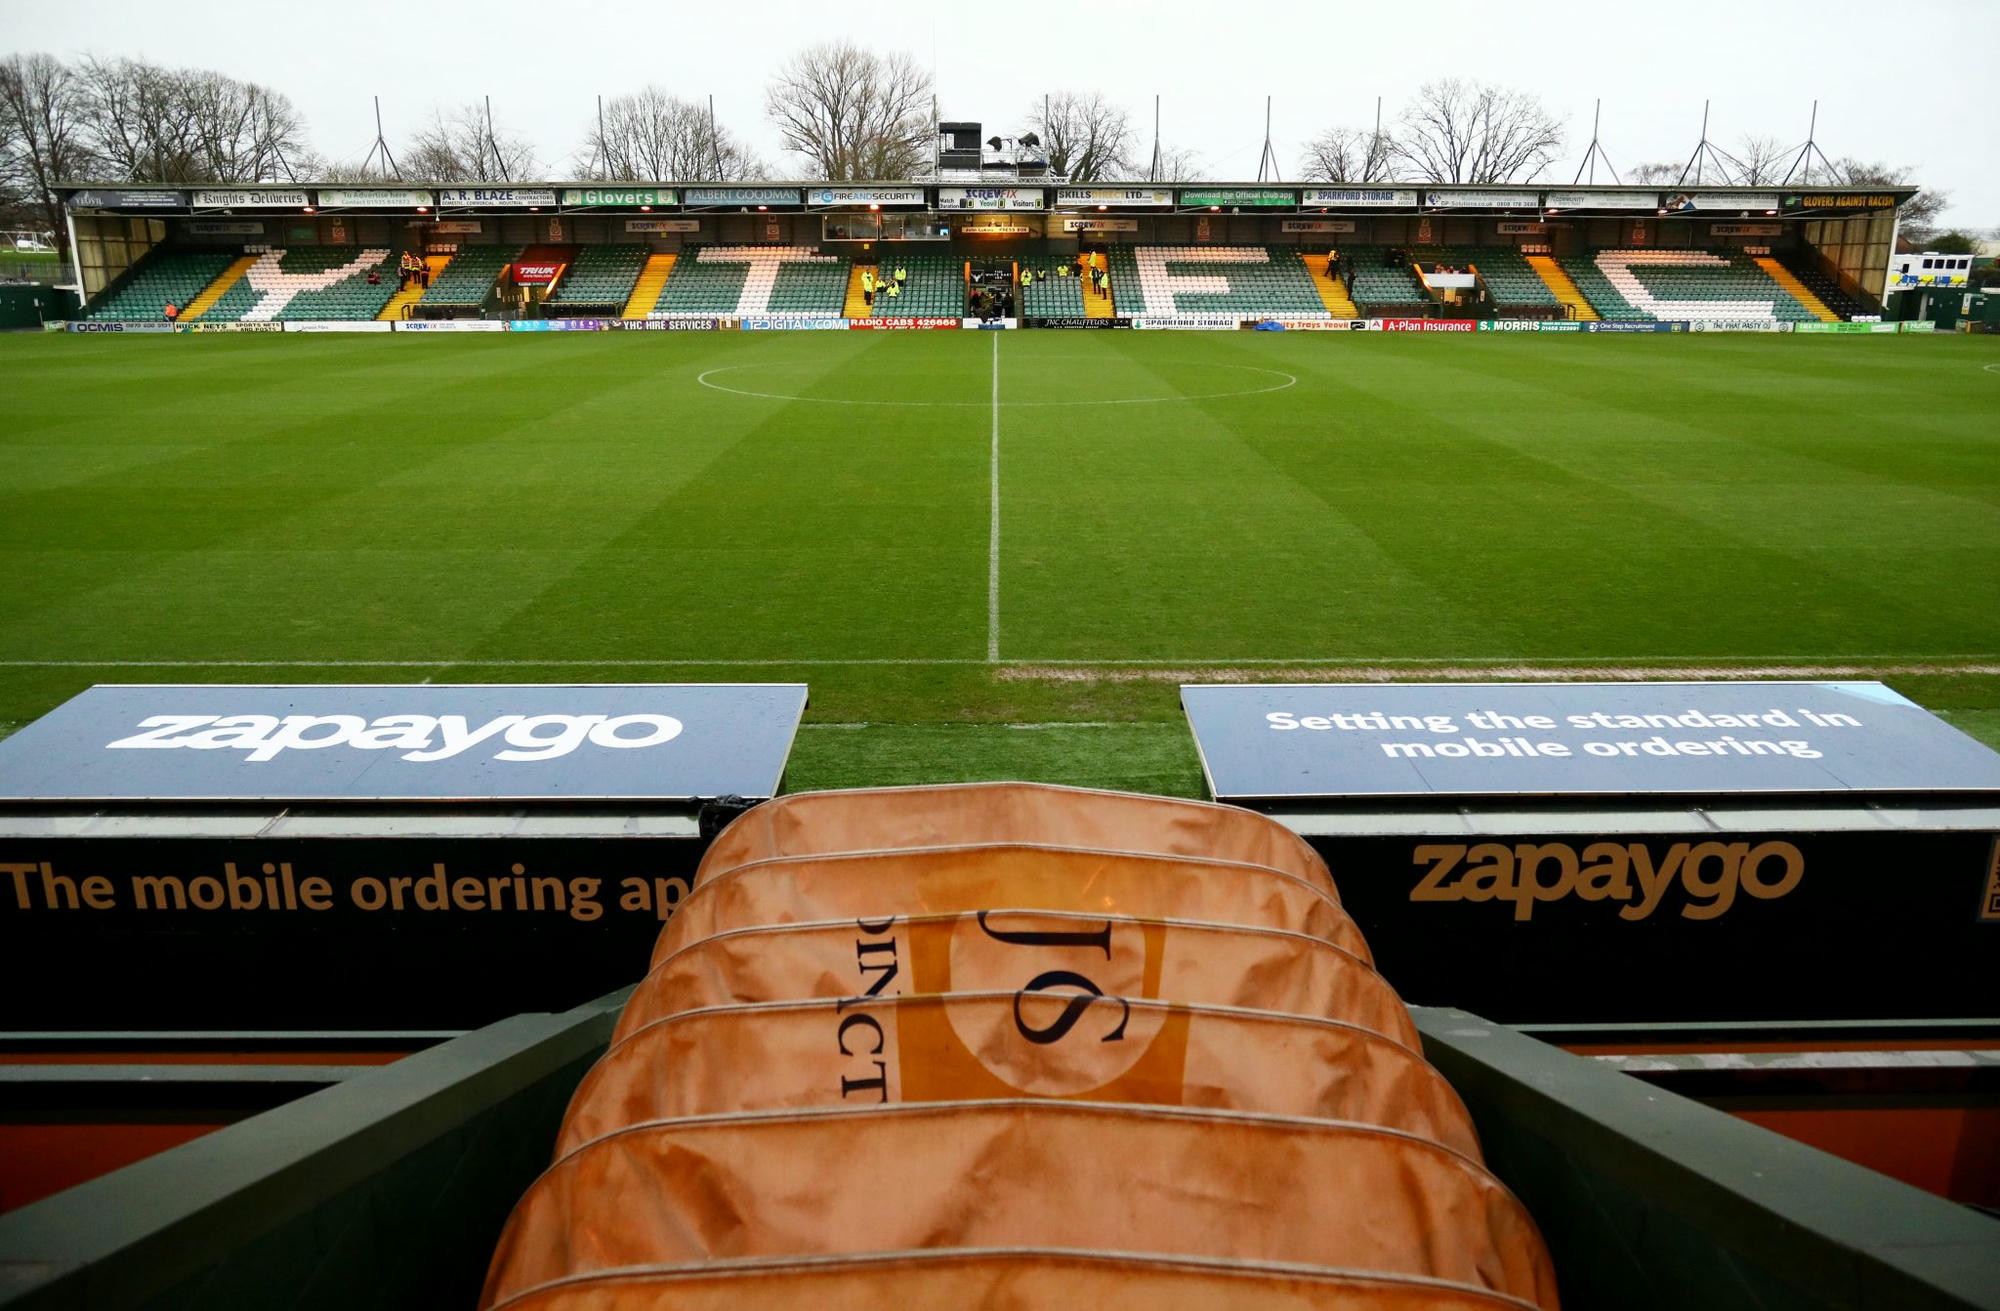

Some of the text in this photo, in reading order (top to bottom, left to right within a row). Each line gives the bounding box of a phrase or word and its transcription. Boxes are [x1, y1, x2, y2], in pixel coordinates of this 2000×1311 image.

[203, 192, 303, 206] Knights Deliveries
[442, 191, 513, 201] A. R. BLAZE
[586, 191, 654, 204] Glovers
[694, 190, 800, 200] ALBERT GOODMAN
[965, 189, 1018, 200] SCREWFIX
[1184, 190, 1293, 200] Download the Official Club app
[1318, 191, 1394, 201] SPARKFORD STORAGE
[980, 199, 997, 207] Yeovil
[1012, 200, 1034, 208] Visitors
[1803, 195, 1895, 208] GLOVERS AGAINST RACISM
[77, 323, 123, 332] OCMIS
[623, 320, 712, 330] YHC HIRE SERVICES
[1298, 321, 1321, 329] Trays
[1388, 321, 1471, 331] A-Plan Insurance
[1493, 321, 1540, 331] MORRIS
[1265, 709, 1862, 733] Setting the standard in
[106, 713, 682, 762] zapaygo
[1380, 736, 1823, 759] mobile ordering
[1410, 842, 1804, 921] zapaygo
[0, 863, 691, 921] The mobile ordering ap
